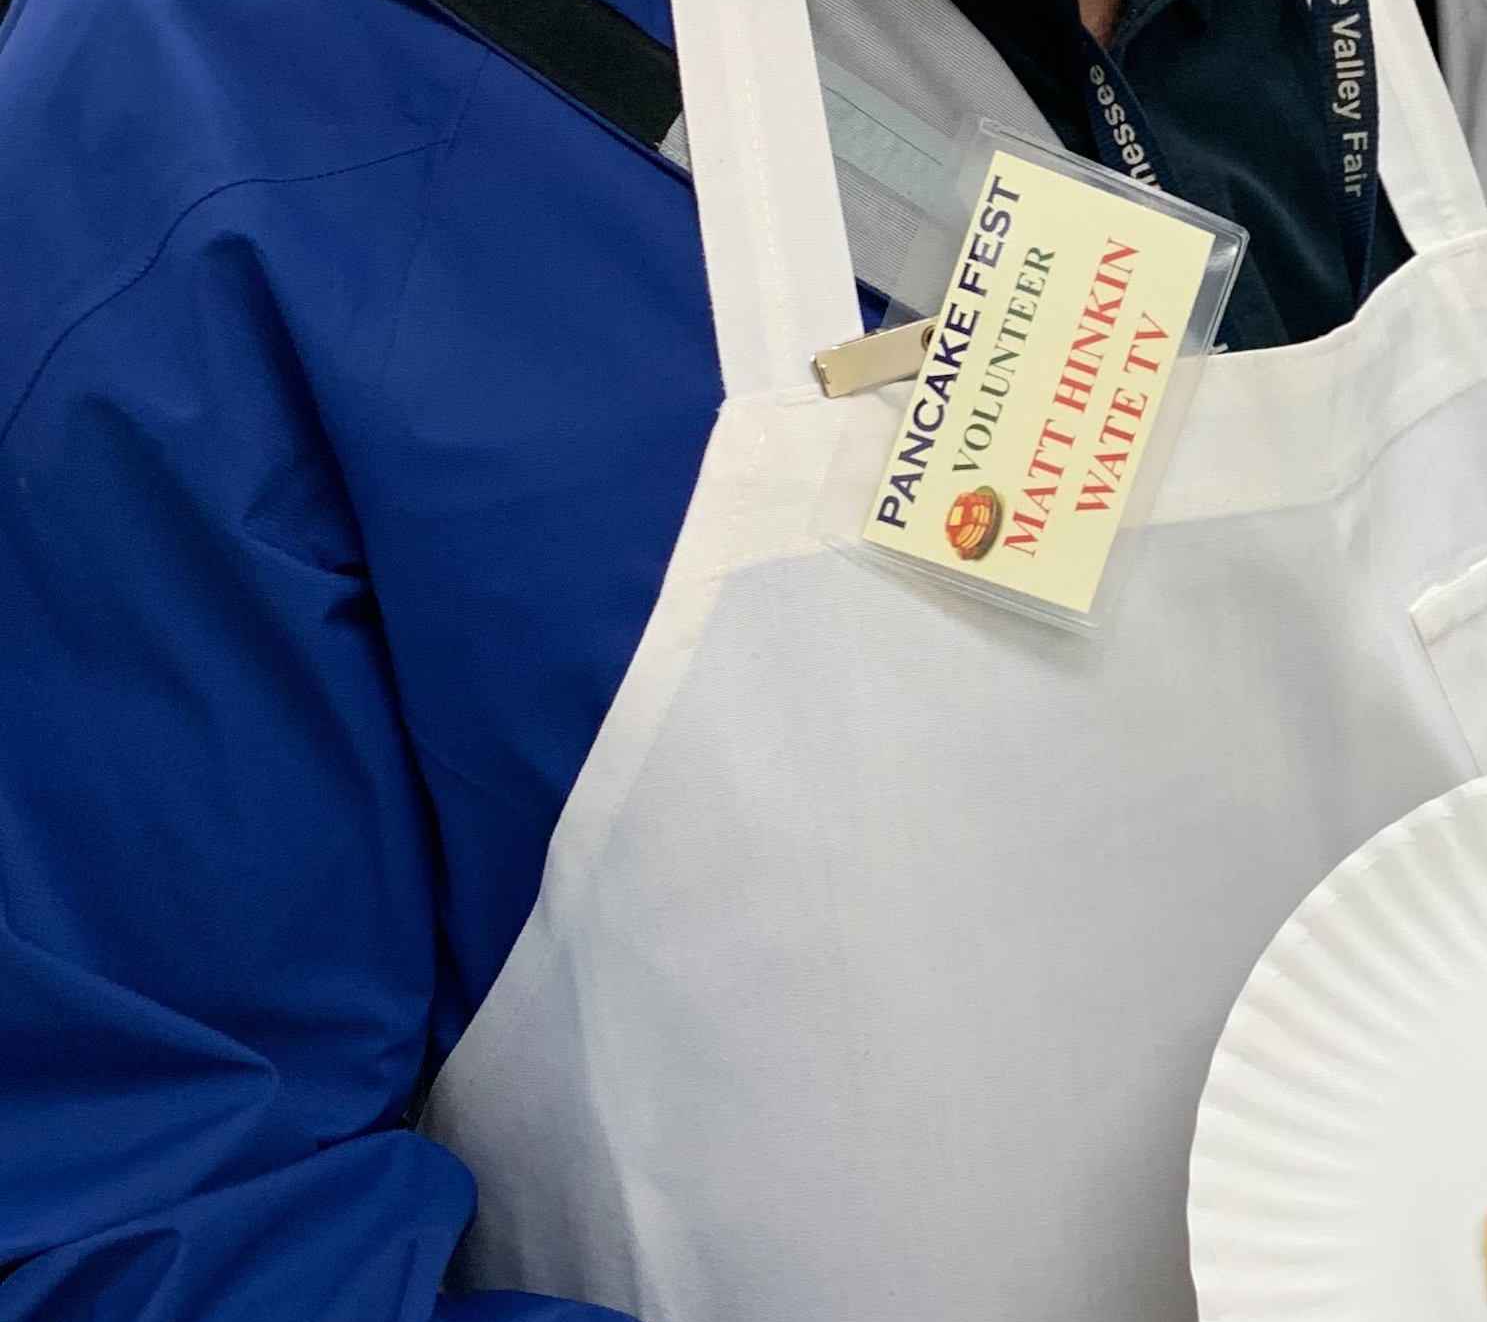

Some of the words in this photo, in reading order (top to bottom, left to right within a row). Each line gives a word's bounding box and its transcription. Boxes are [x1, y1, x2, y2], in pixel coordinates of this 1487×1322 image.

[1088, 64, 1162, 190] nessee
[1332, 13, 1366, 120] Valley
[1342, 131, 1370, 198] Fair
[876, 303, 981, 529] PANCAKE
[958, 176, 1021, 298] FEST
[951, 245, 1057, 474] VOLUNTEER
[1002, 419, 1076, 557] MATT
[1052, 236, 1140, 414] HINKIN
[1074, 387, 1149, 513] WATE
[1122, 311, 1170, 374] TV
